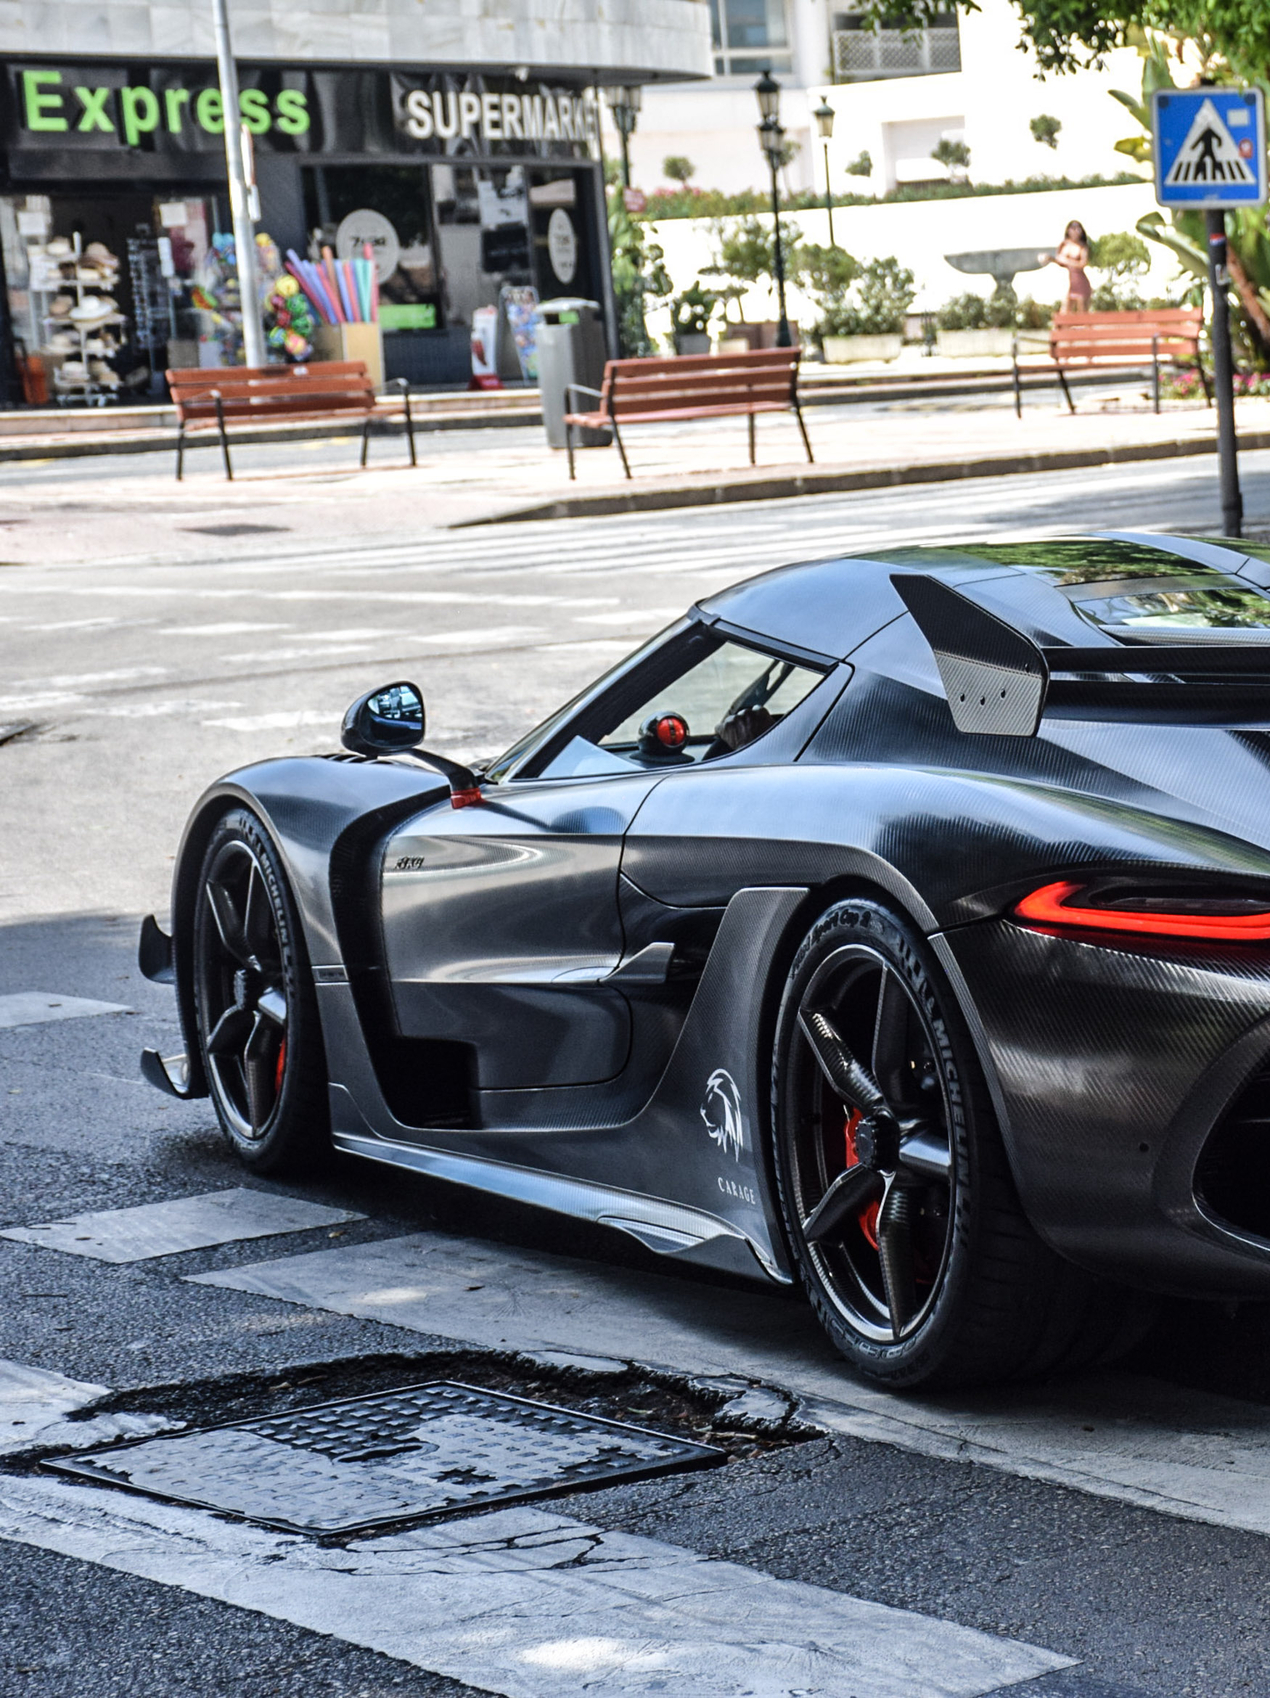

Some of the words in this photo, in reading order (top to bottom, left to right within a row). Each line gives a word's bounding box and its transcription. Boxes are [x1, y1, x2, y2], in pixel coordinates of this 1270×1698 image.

[23, 69, 311, 147] Express
[260, 852, 290, 945] MICHELIN
[931, 1016, 970, 1187] MICHELIN
[717, 1176, 756, 1205] CARAGE
